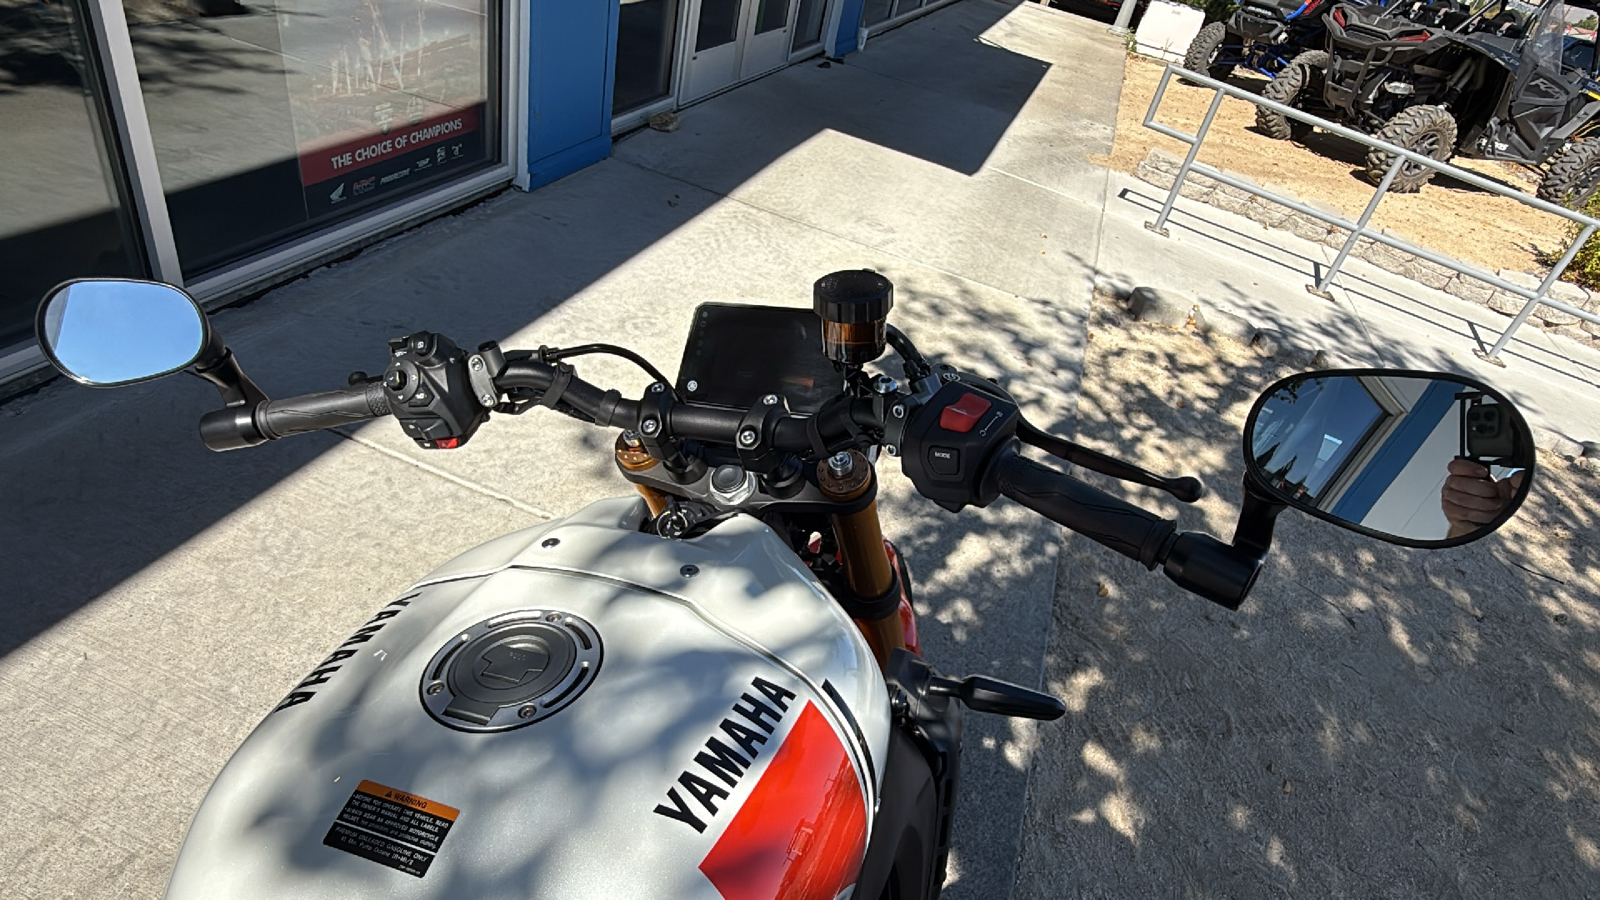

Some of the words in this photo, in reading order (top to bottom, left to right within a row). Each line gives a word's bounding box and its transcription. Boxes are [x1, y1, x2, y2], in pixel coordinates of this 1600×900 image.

[331, 152, 353, 169] THE
[355, 139, 393, 162] CHOICE
[394, 134, 408, 149] OF
[410, 118, 462, 144] CHAMPIONS
[934, 451, 951, 459] MODE
[274, 591, 423, 713] YAMAHA
[653, 676, 797, 834] YAMAHA
[394, 792, 428, 809] WARNING
[400, 815, 411, 823] AND
[410, 819, 419, 827] ALL
[435, 819, 449, 829] READ
[409, 827, 440, 842] MOTORCYCLE
[359, 834, 386, 848] UNLEADED
[386, 843, 413, 858] GASOLINE
[413, 852, 429, 863] ONLY
